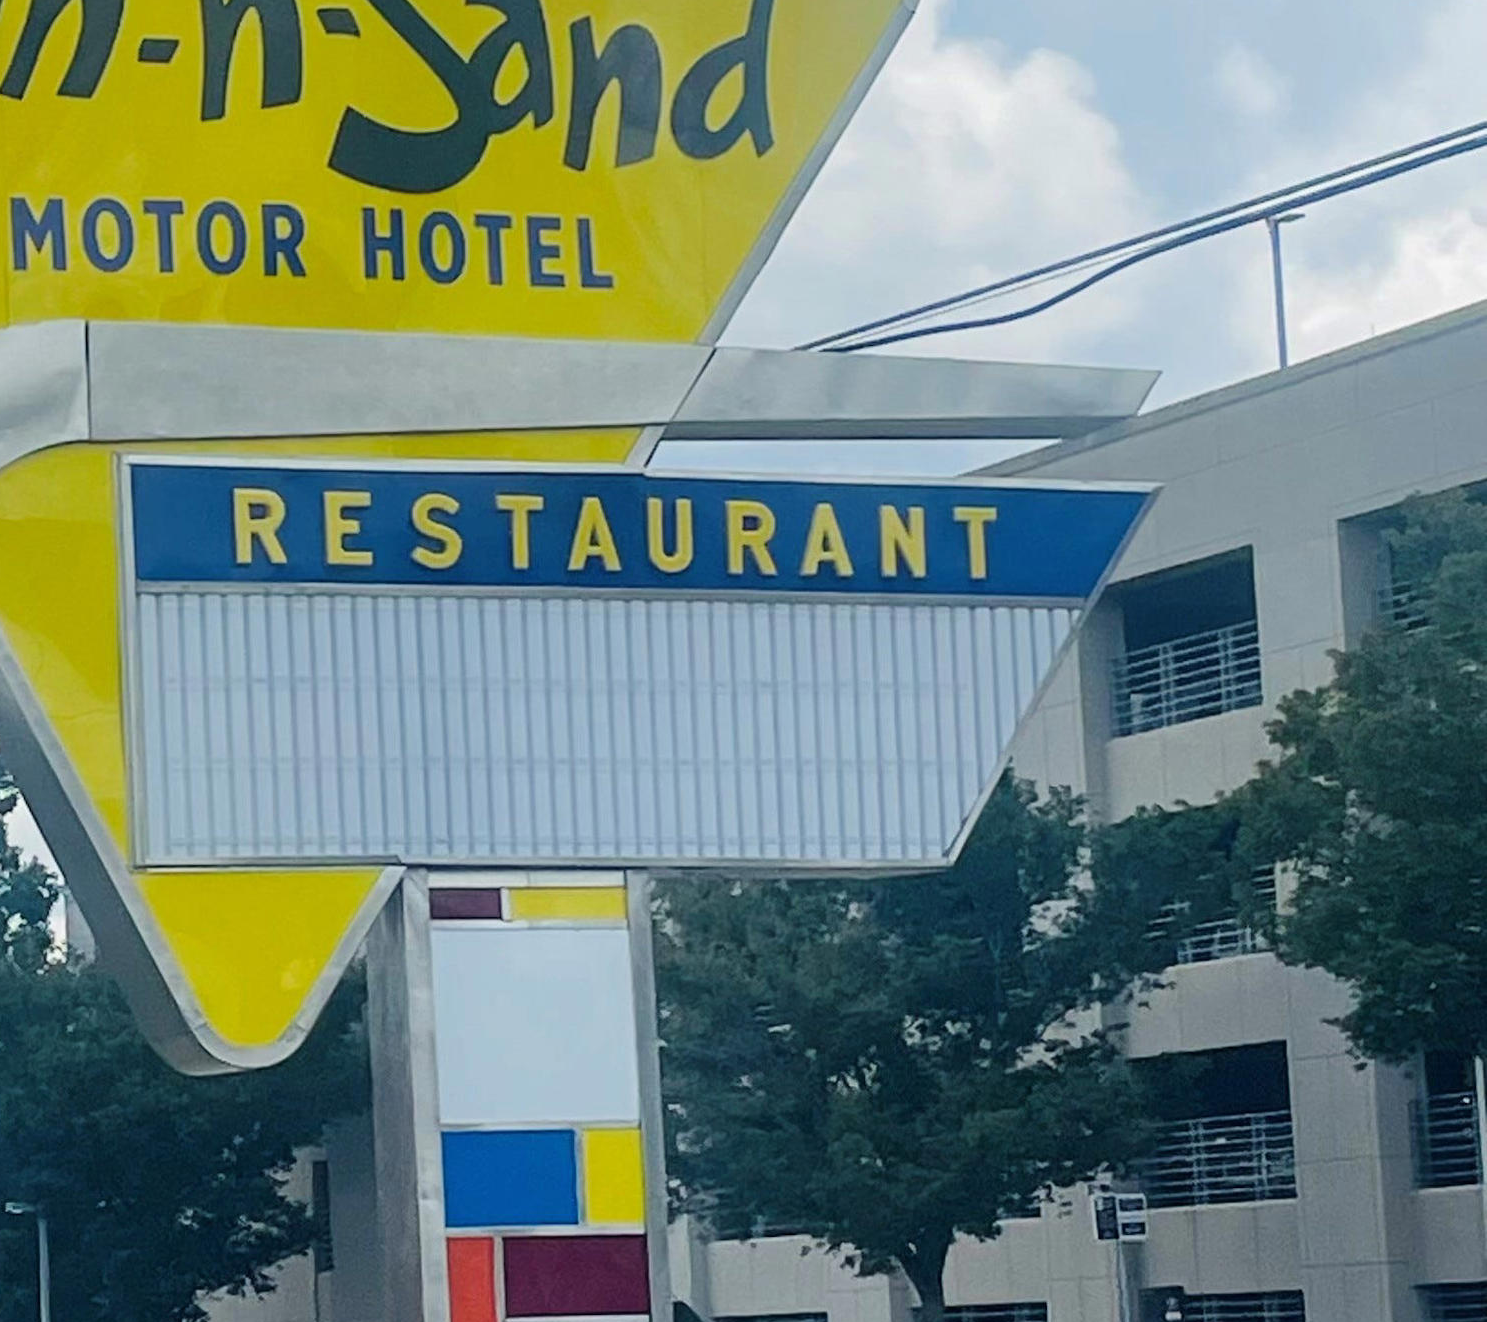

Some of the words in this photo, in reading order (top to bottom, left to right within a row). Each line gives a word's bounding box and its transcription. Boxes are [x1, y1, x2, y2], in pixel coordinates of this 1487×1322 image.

[8, 195, 309, 280] MOTOR
[359, 205, 617, 291] HOTEL
[232, 486, 999, 580] RESTAURANT
